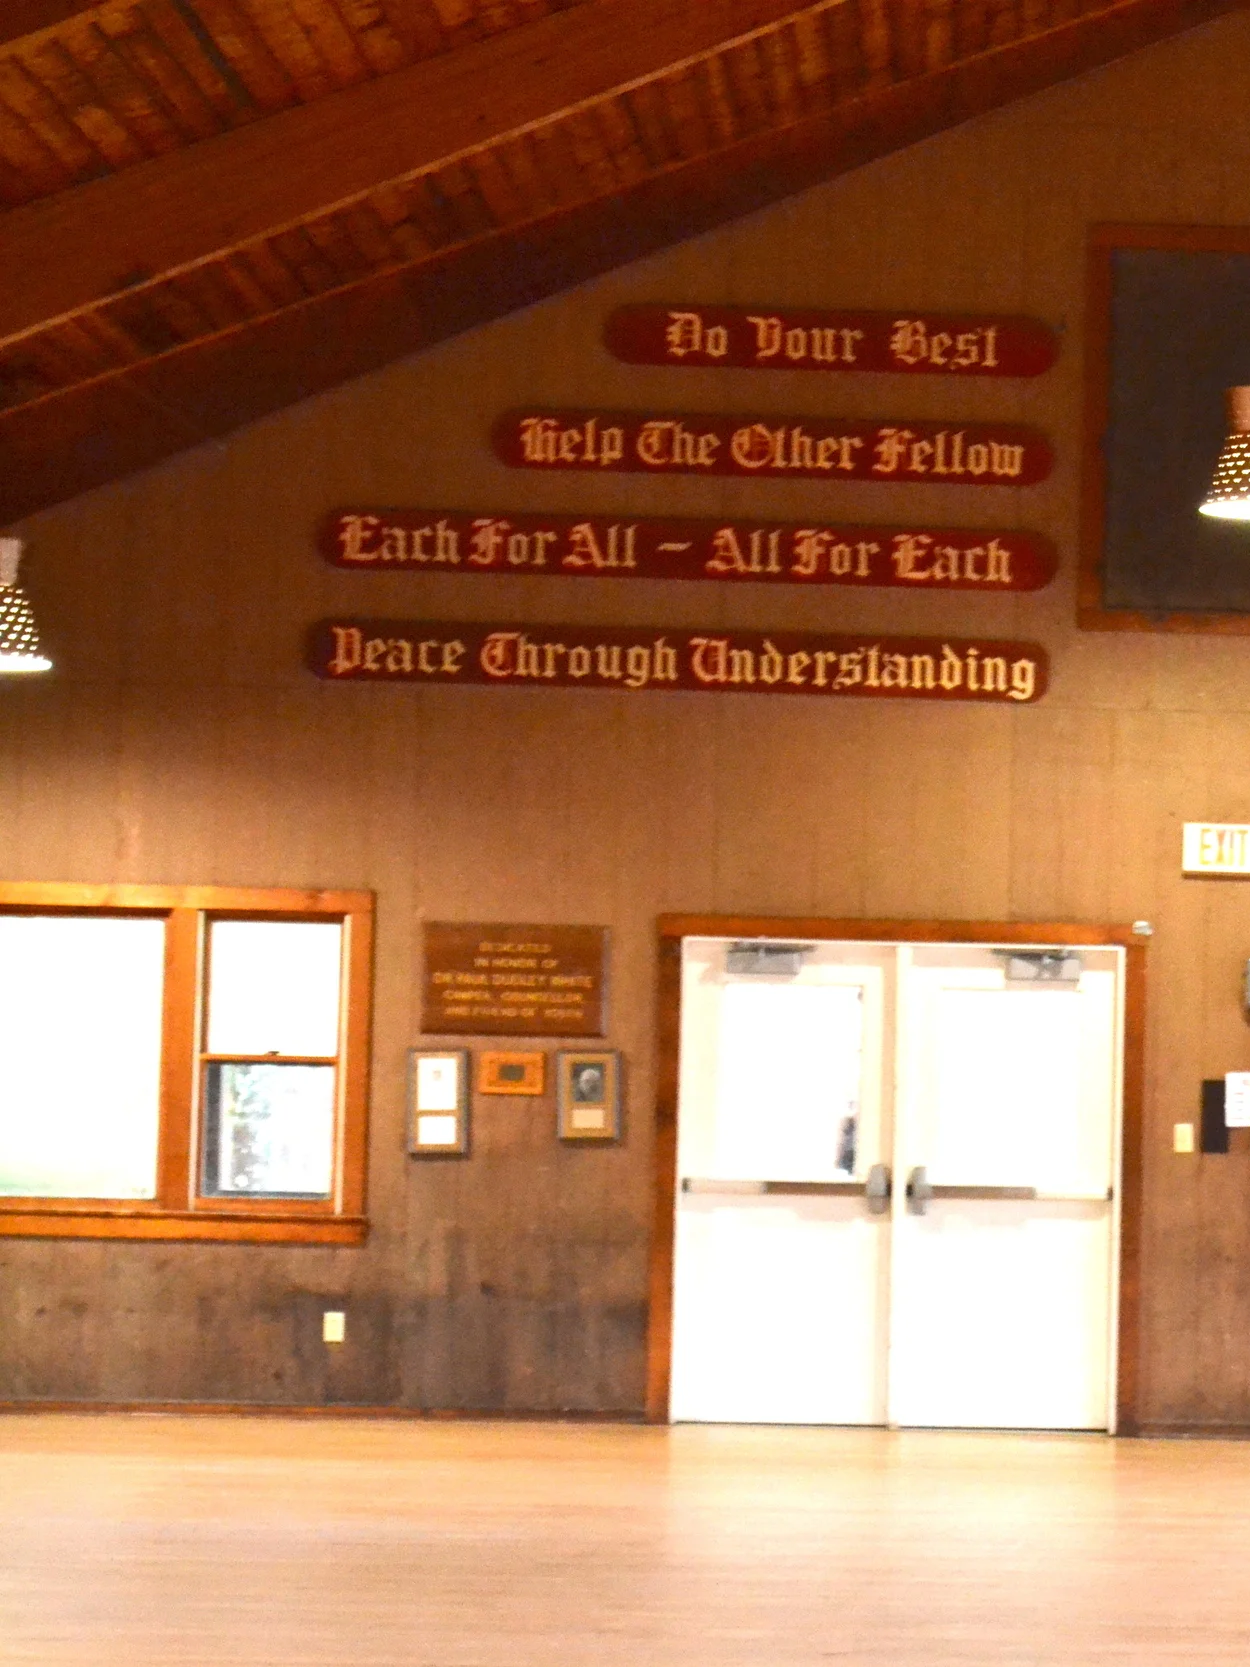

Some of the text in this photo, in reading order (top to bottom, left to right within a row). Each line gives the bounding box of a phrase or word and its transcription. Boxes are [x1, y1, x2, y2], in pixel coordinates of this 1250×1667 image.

[666, 312, 999, 371] Do Your Best
[519, 416, 1024, 478] Help The Other Fellow
[339, 514, 459, 564] Each
[470, 520, 558, 565] For
[561, 522, 638, 569] All
[706, 528, 782, 574] All
[790, 530, 880, 578] For
[890, 534, 1014, 582] Each
[329, 626, 1036, 700] Peace Through Understanding
[1200, 828, 1248, 866] EXIT
